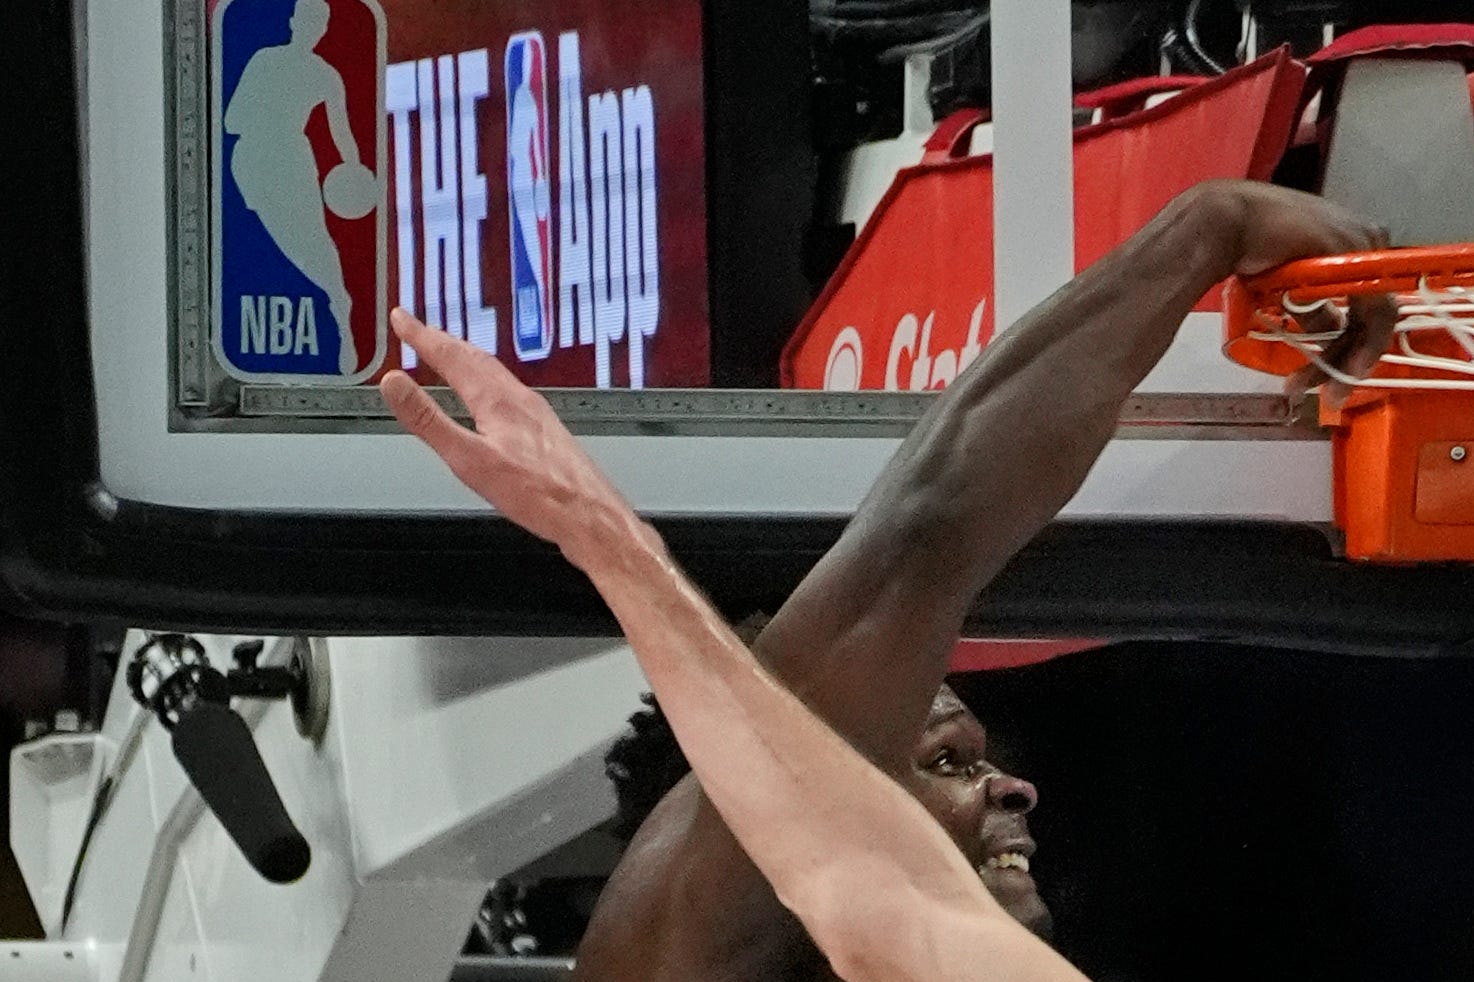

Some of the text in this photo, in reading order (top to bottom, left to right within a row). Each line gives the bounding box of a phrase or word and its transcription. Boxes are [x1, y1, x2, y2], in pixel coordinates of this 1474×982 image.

[386, 31, 660, 390] THE App
[240, 295, 319, 356] NBA
